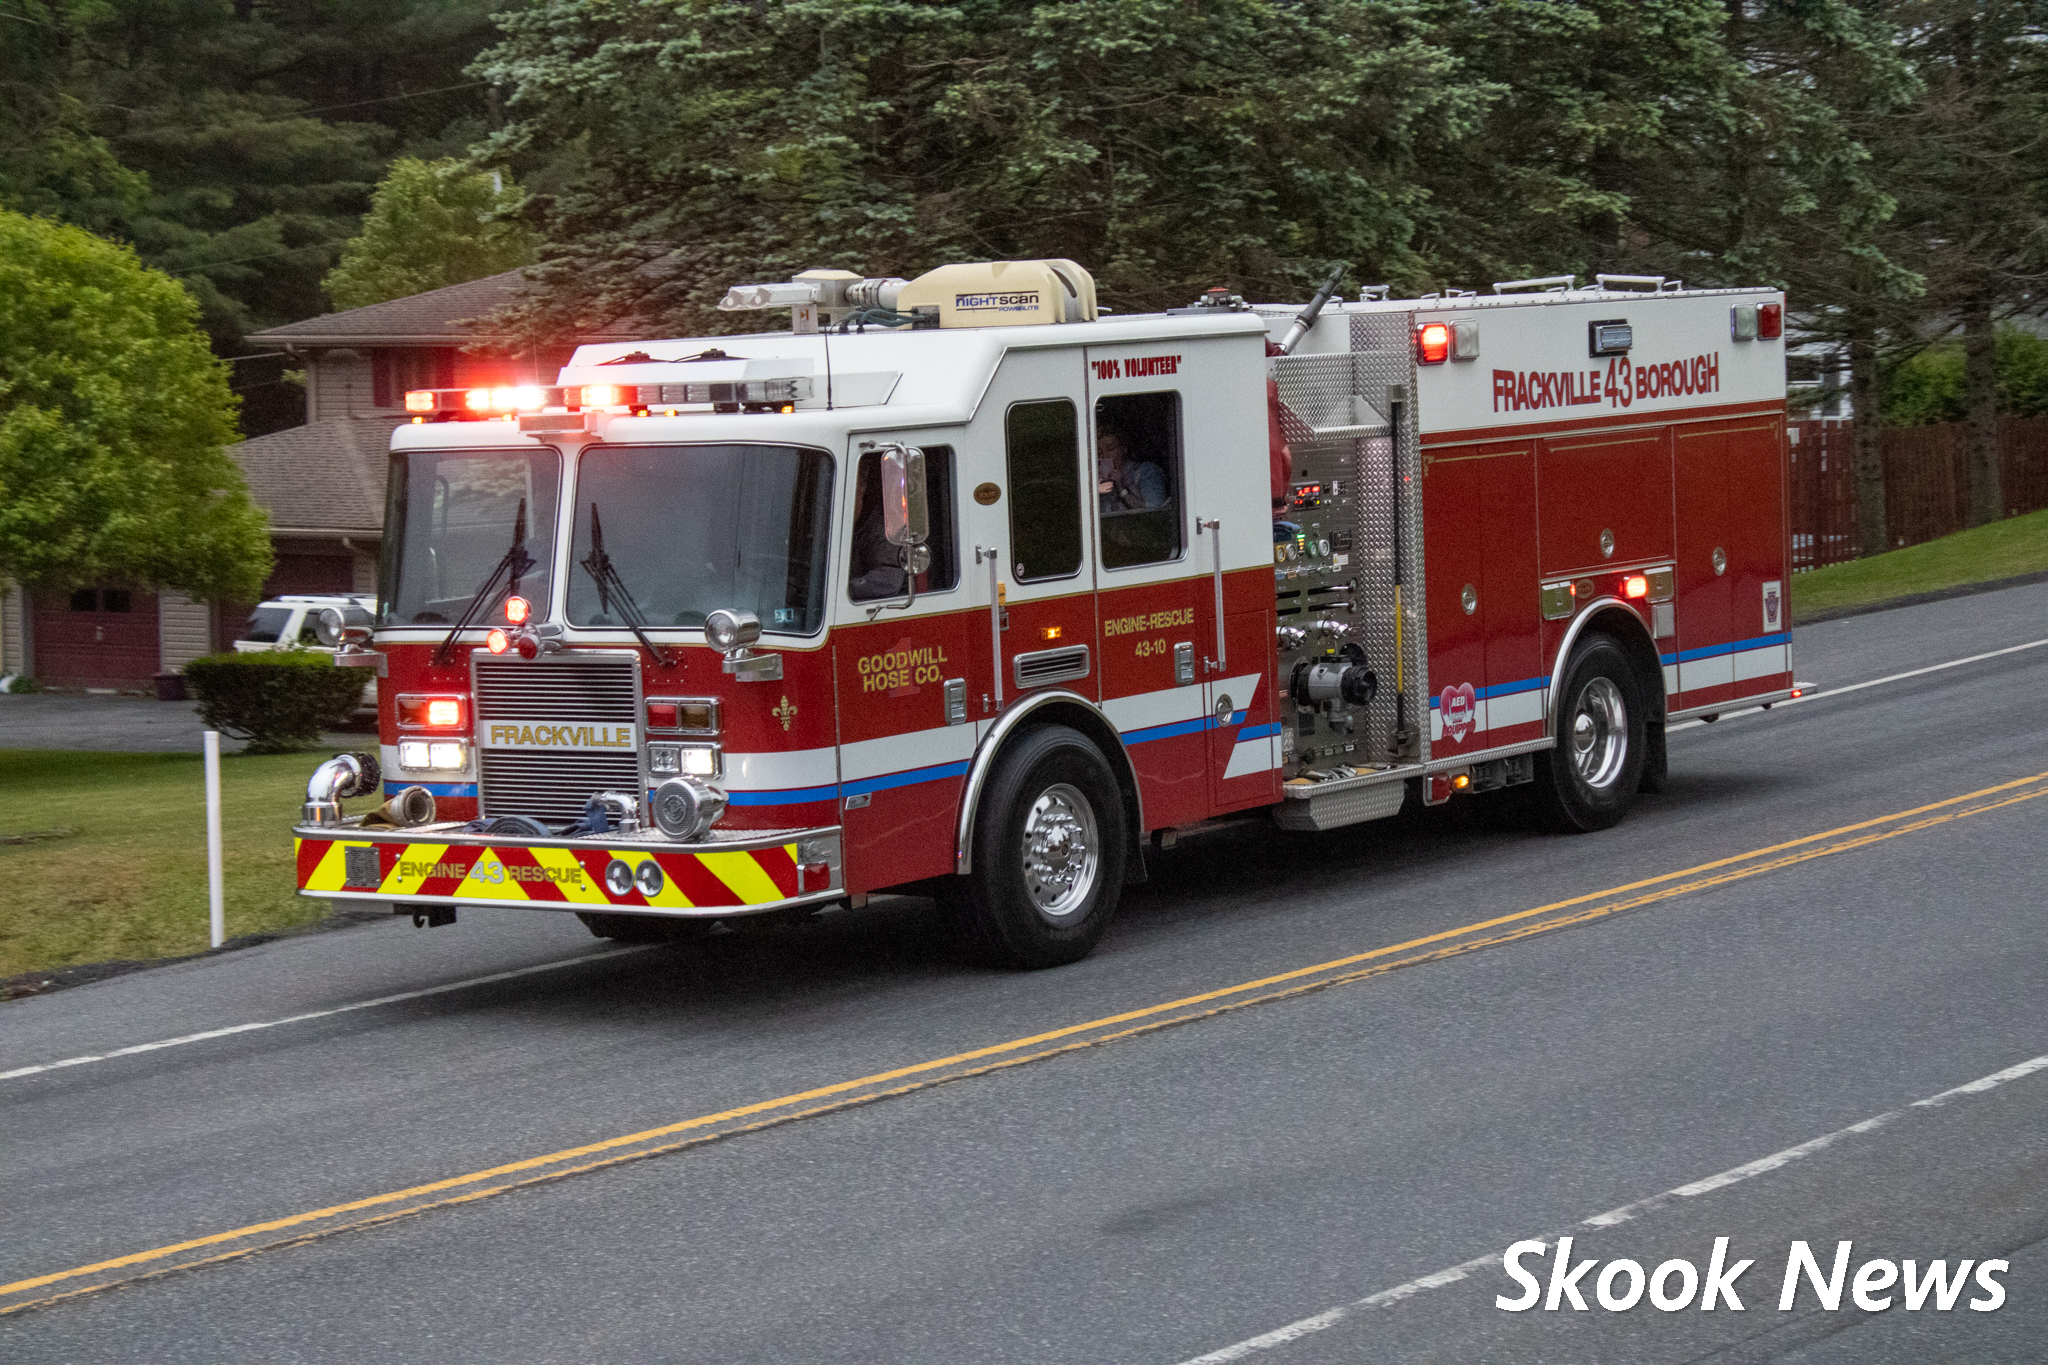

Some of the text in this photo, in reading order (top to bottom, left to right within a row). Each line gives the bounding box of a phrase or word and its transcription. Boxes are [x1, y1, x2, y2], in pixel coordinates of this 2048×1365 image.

[1492, 351, 1719, 413] FRACKVILLE 43 BOROUGH
[1104, 607, 1195, 637] ENGINE-RESCUE
[858, 646, 948, 675] GOODWILL
[1135, 638, 1166, 657] 43-10
[863, 665, 943, 693] HOSE CO.
[1451, 696, 1466, 708] AED
[490, 724, 632, 748] FRACKVILLE
[399, 860, 583, 884] ENGINE 43 RESCUE
